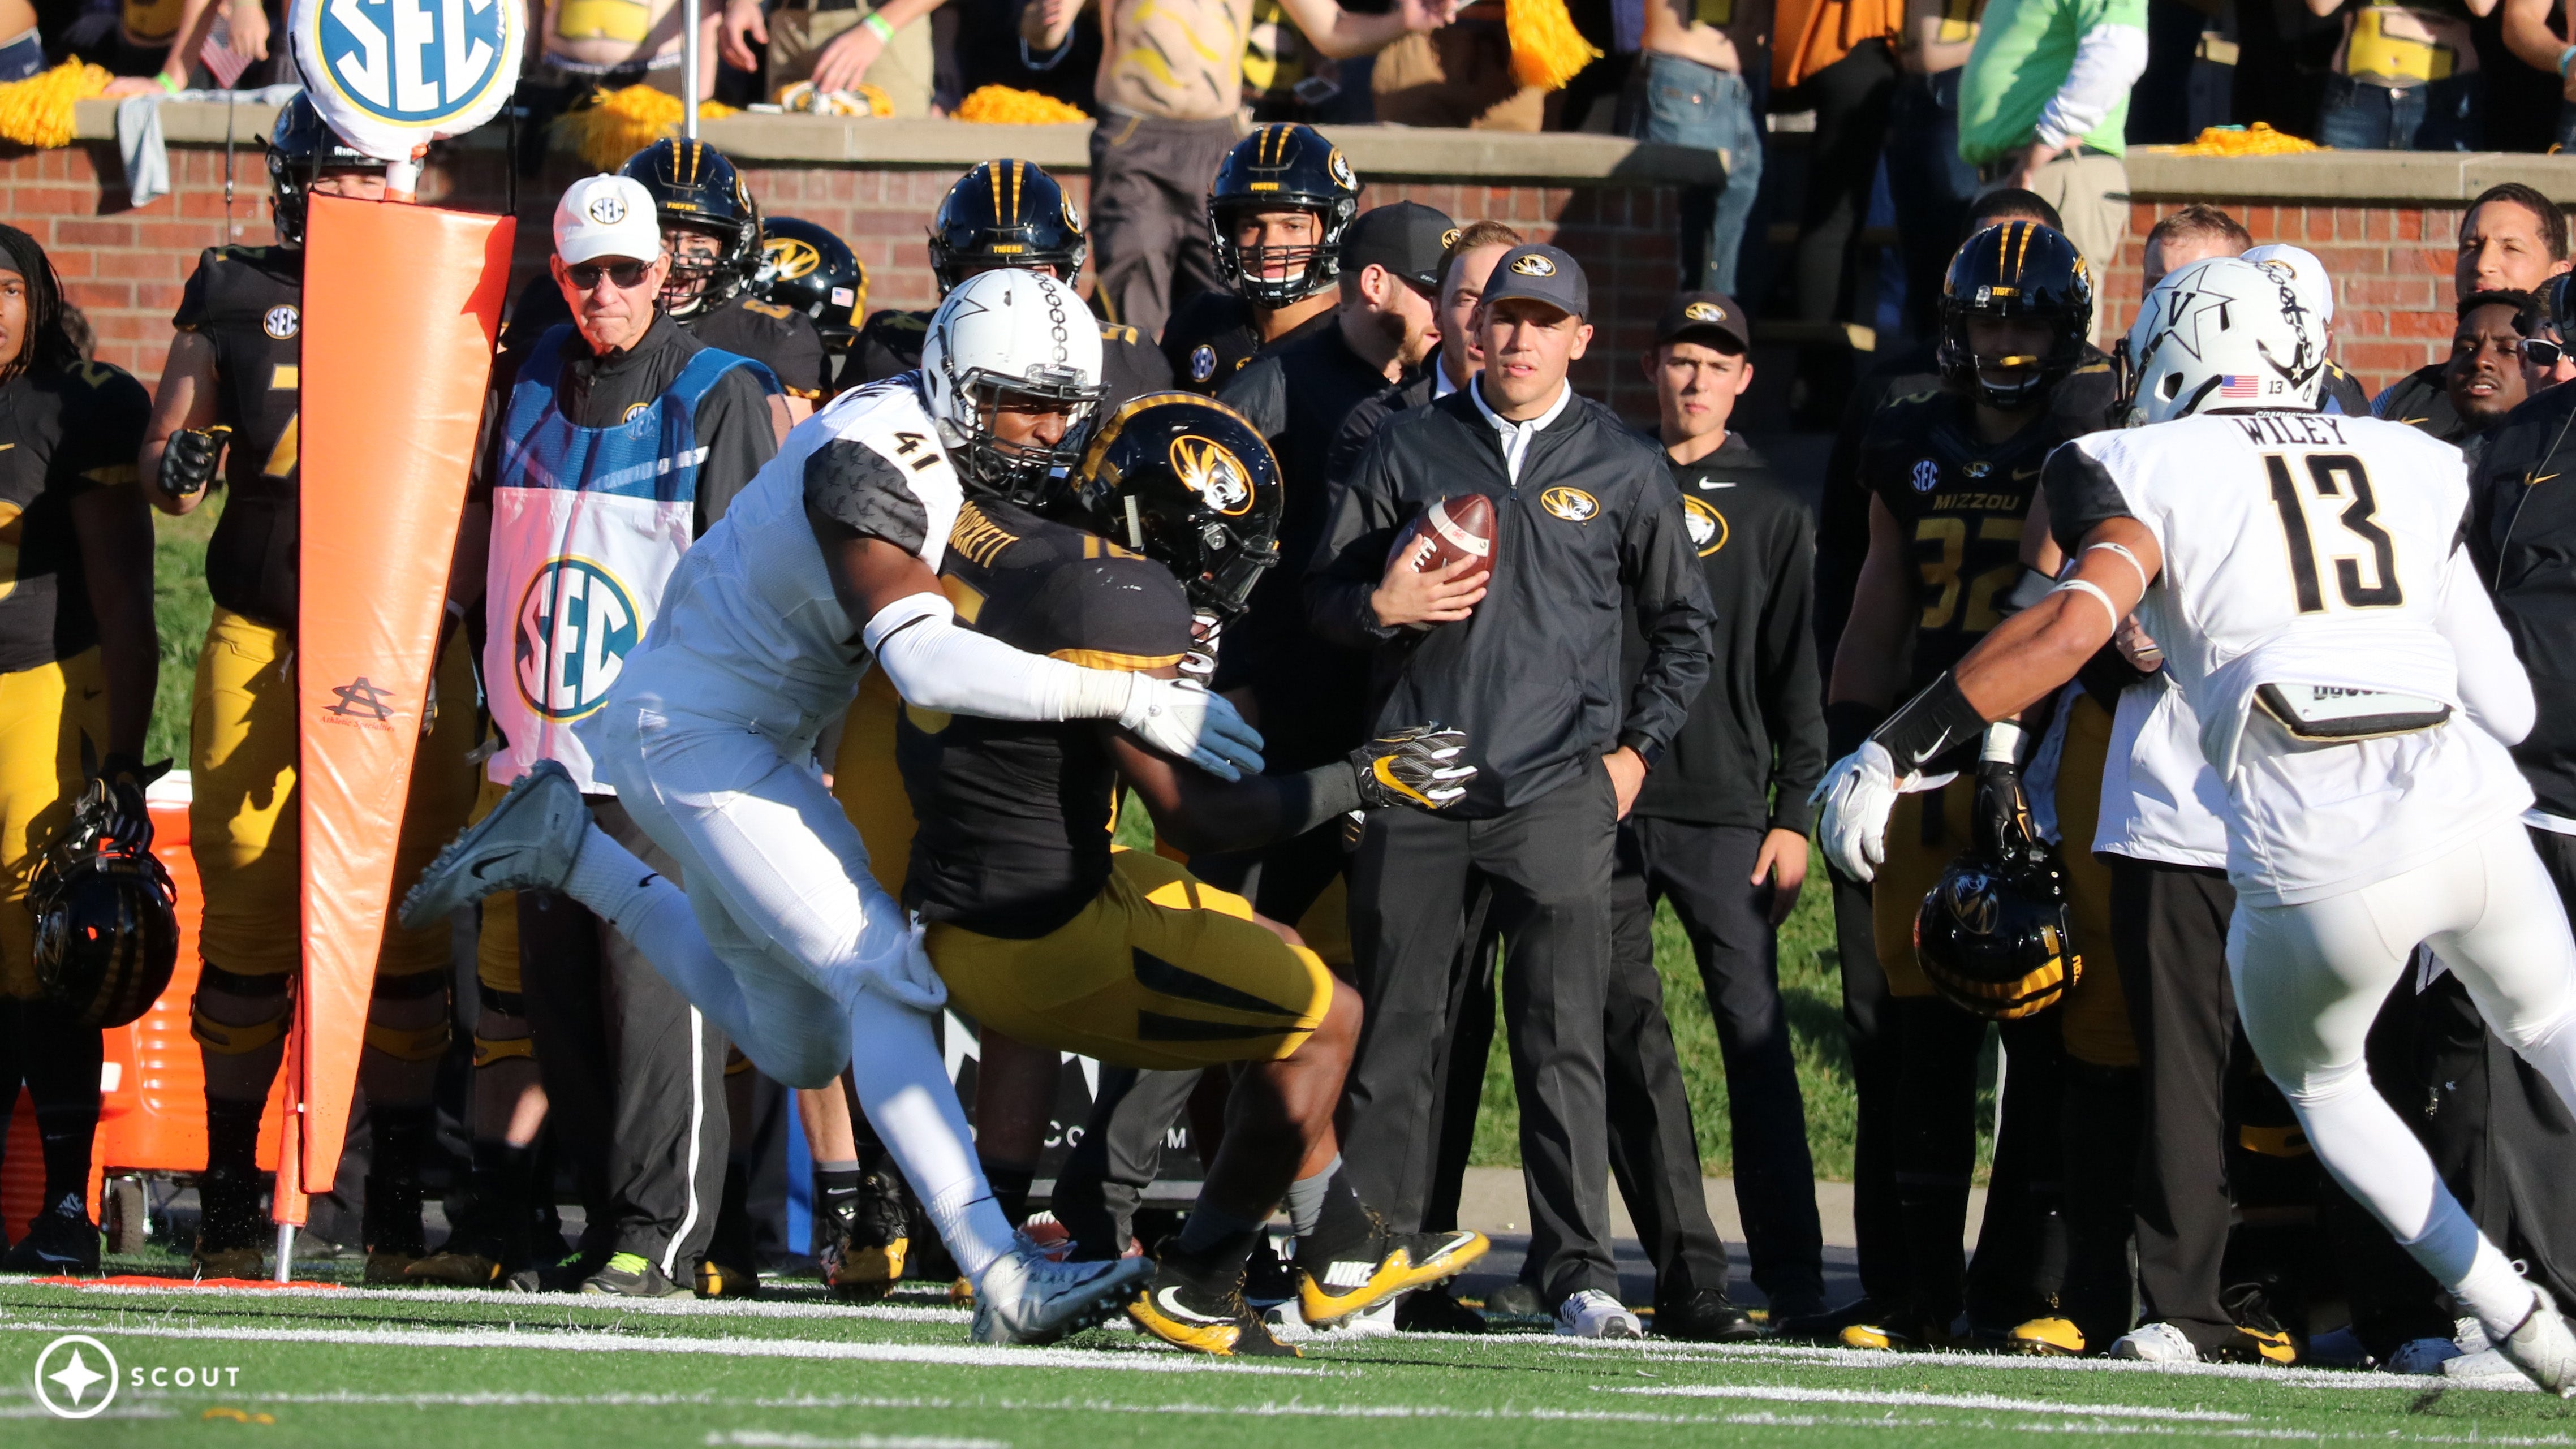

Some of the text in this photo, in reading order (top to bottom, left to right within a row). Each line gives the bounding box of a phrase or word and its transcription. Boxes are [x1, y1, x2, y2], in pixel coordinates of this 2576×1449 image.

[330, 0, 493, 112] SEC
[592, 198, 626, 223] SEC
[992, 244, 1023, 253] TIGERS
[1992, 286, 2020, 296] TIGERS
[267, 308, 298, 336] SEC
[2268, 381, 2283, 395] 13
[2233, 416, 2348, 446] WILEY
[892, 431, 944, 473] 41
[1912, 460, 1938, 492] SEC
[1932, 493, 2020, 510] MIZZOU
[2259, 451, 2406, 616] 13
[1914, 517, 2026, 632] 32
[520, 567, 628, 710] SEC
[320, 715, 395, 732] Athletic Specialties
[1323, 1261, 1377, 1288] NIKE
